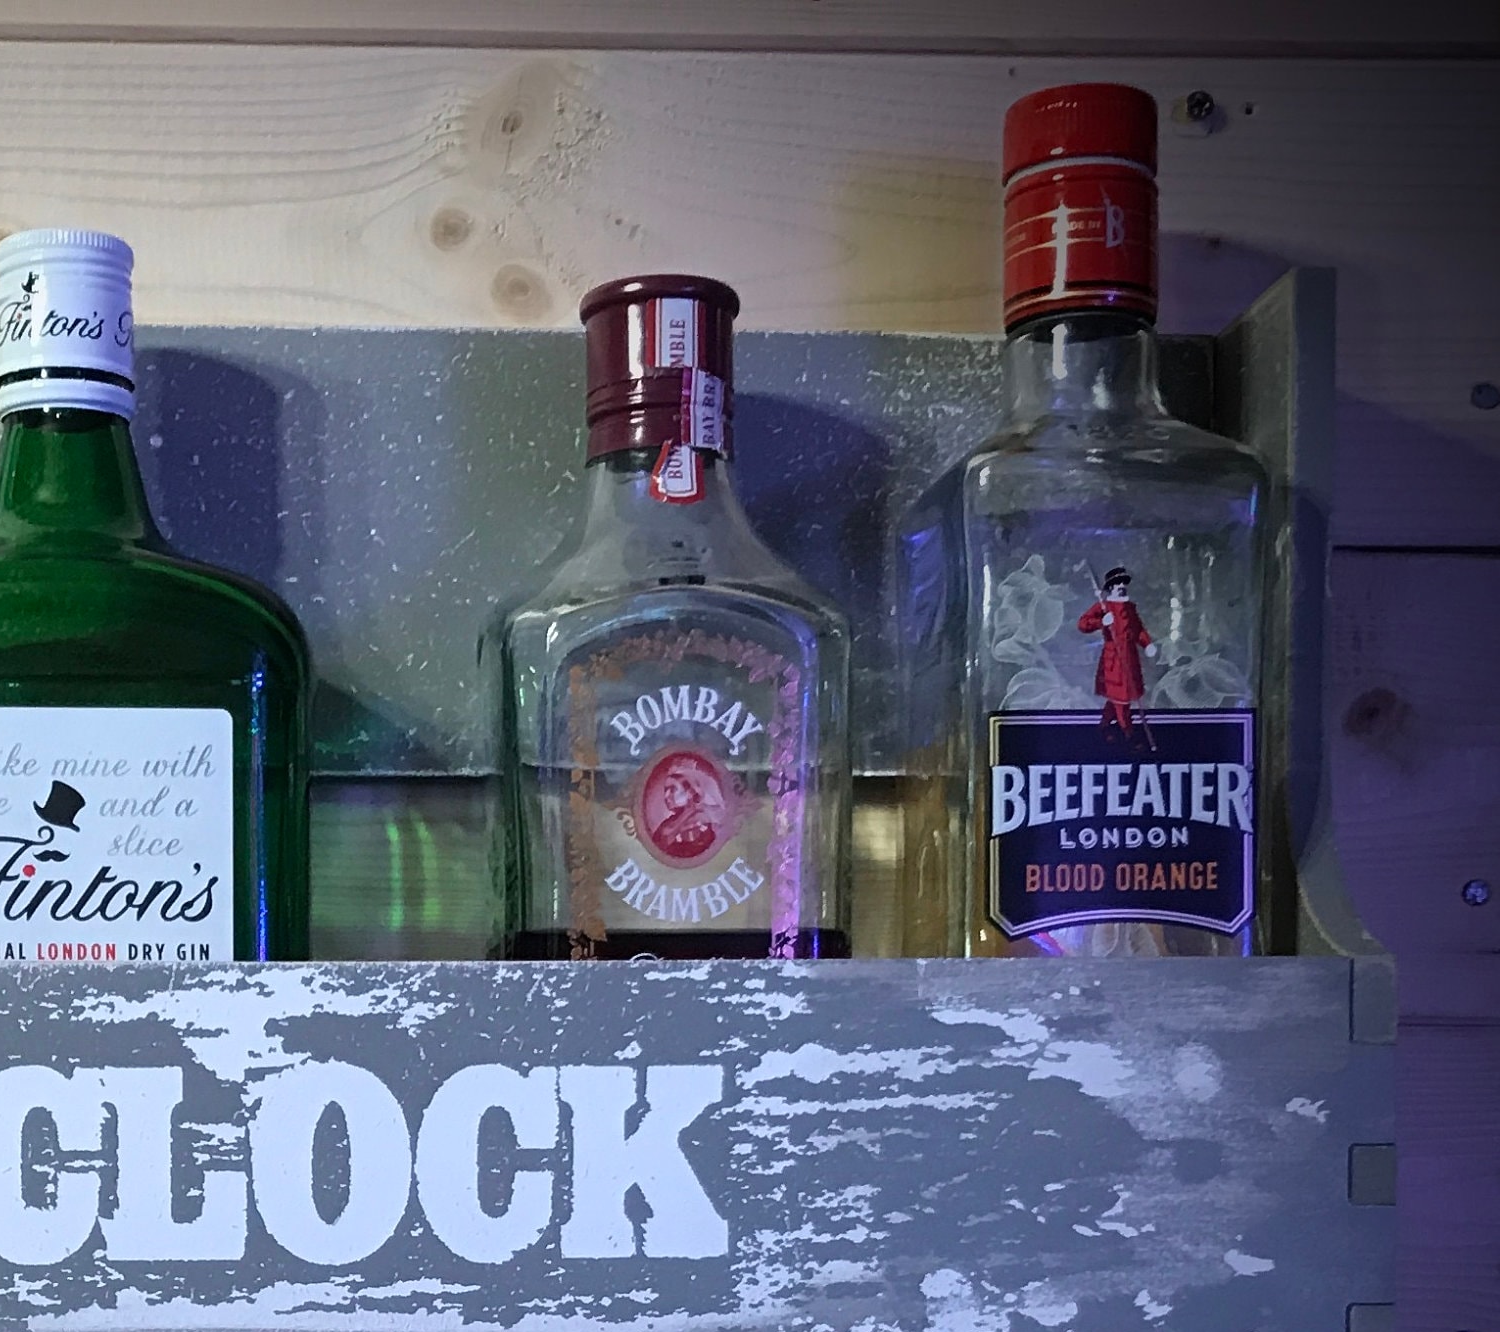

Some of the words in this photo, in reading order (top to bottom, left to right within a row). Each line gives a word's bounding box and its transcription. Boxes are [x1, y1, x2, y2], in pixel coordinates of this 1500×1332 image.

[610, 684, 764, 756] BOMBAY
[50, 752, 131, 777] mine
[142, 744, 216, 777] with
[98, 786, 171, 817] and
[175, 797, 199, 817] a
[991, 763, 1254, 837] BEEFEATER
[106, 824, 185, 857] slice
[1060, 826, 1190, 849] LONDON
[604, 856, 765, 924] BRAMBLE
[1025, 864, 1105, 893] BLOOD
[1115, 862, 1218, 891] ORANGE
[37, 943, 116, 961] LONDON
[128, 943, 165, 961] DRY
[176, 943, 211, 961] GIN
